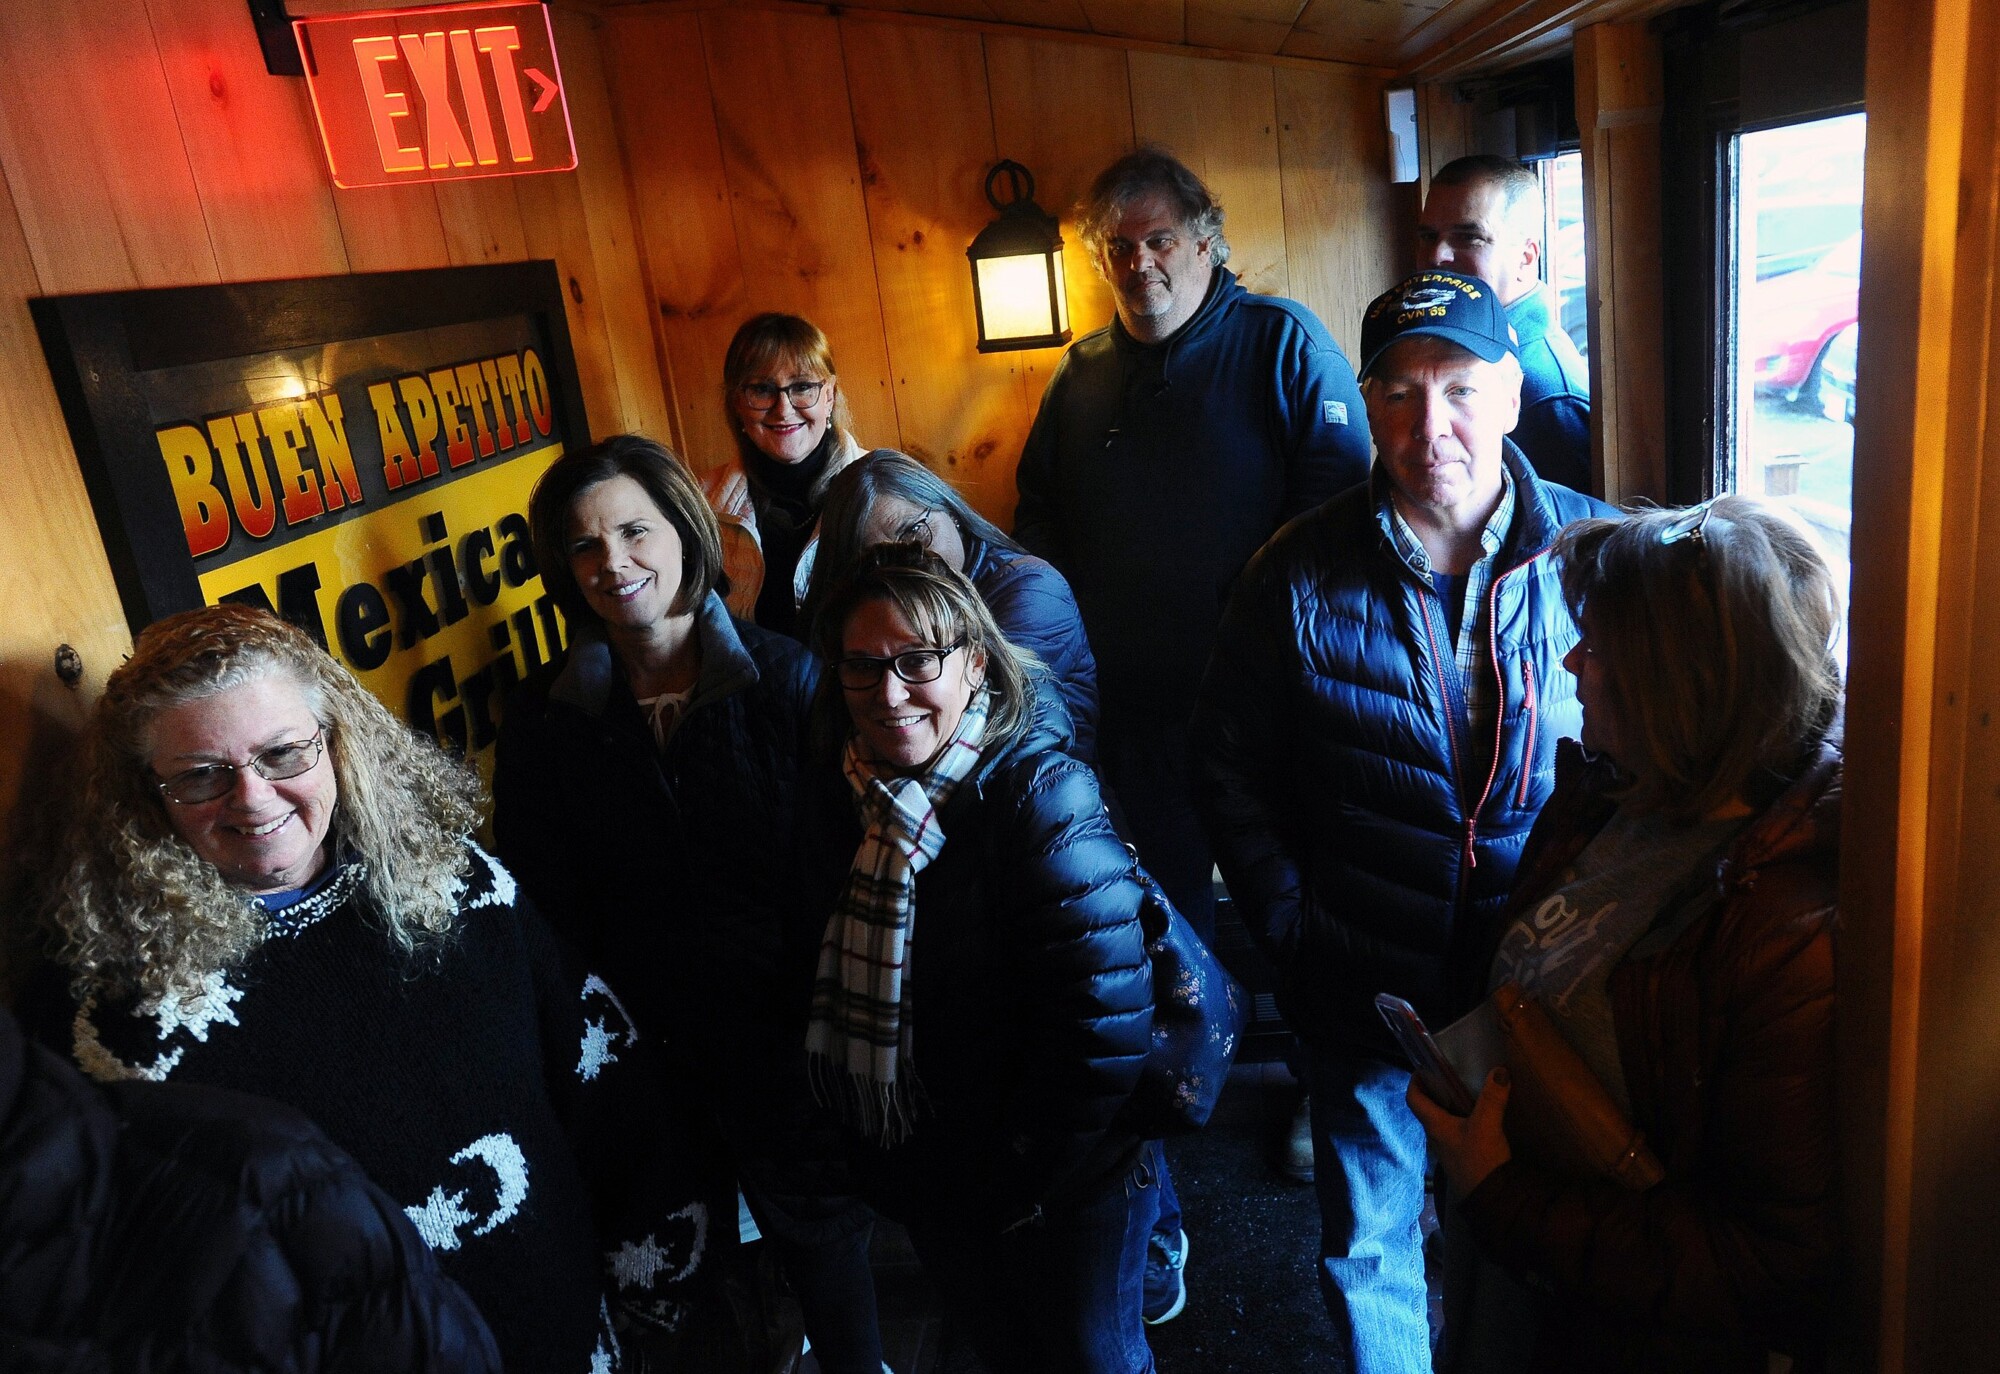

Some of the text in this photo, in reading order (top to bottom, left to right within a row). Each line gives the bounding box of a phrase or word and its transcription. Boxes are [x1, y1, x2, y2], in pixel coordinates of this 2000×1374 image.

[352, 25, 533, 173] EXIT
[1394, 274, 1482, 300] ENTERPRISE
[1396, 309, 1425, 324] CVN
[156, 346, 554, 558] BUEN APETITO
[218, 511, 539, 670] Mexica
